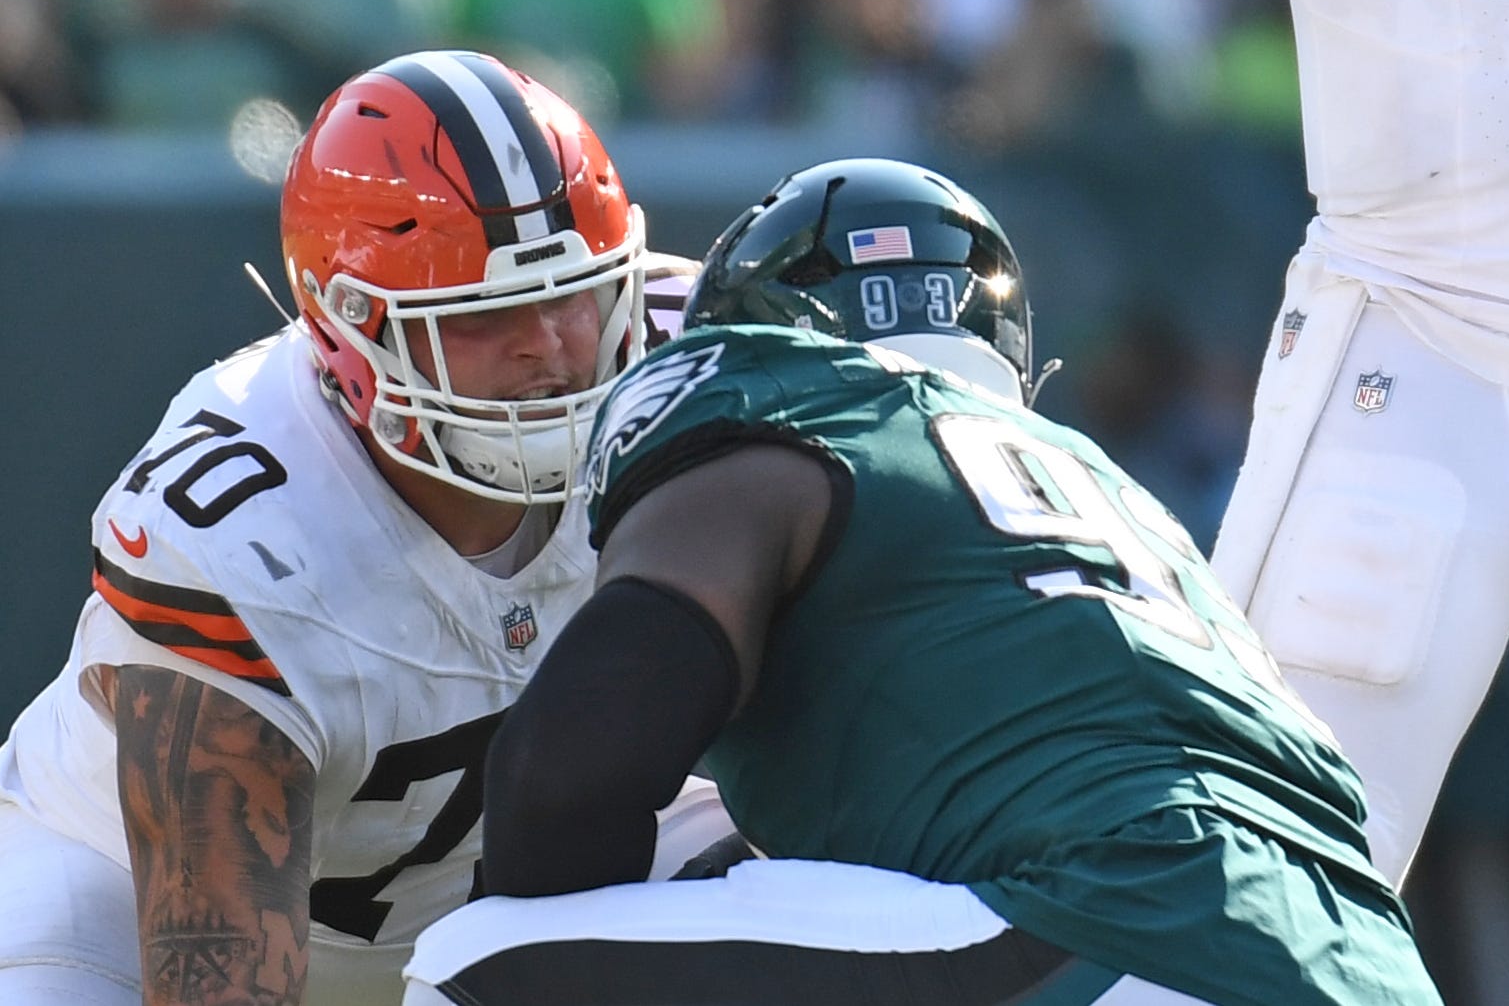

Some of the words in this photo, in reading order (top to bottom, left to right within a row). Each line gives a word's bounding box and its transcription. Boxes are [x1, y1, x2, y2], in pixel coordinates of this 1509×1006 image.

[513, 240, 567, 267] BROWNS
[860, 272, 959, 331] 93
[1358, 387, 1384, 407] NFL
[122, 409, 288, 528] 70
[509, 620, 534, 645] NFL
